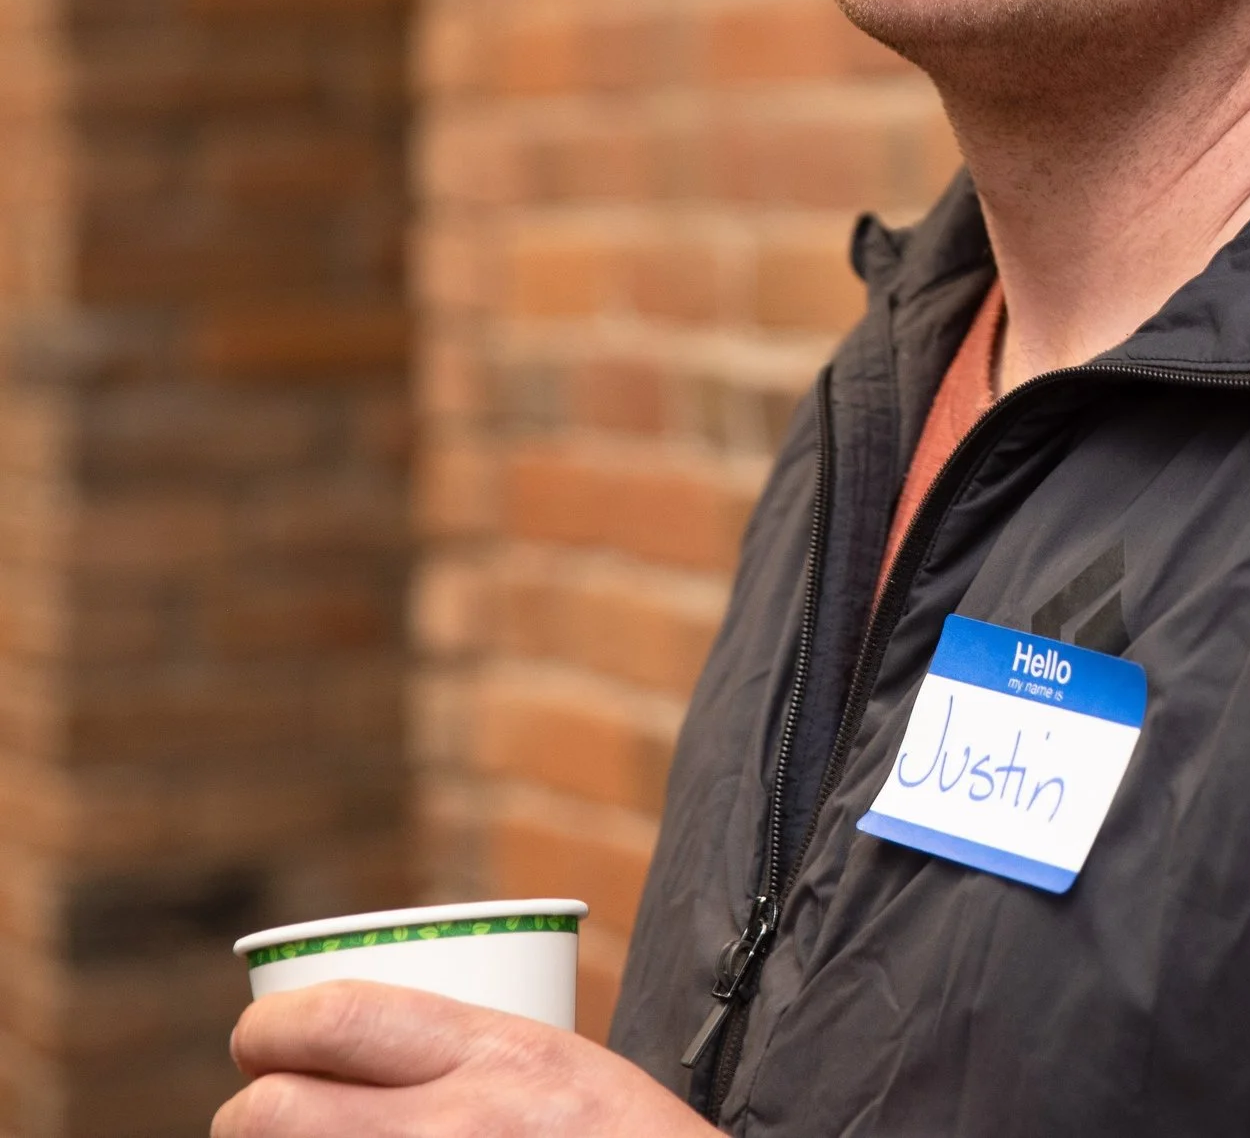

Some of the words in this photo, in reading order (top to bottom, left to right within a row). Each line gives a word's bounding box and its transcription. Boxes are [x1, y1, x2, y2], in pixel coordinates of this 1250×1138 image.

[1012, 641, 1072, 684] Hello
[1008, 678, 1023, 694] my
[1024, 682, 1054, 699] name
[1054, 688, 1064, 702] is
[897, 695, 1065, 823] Justin
